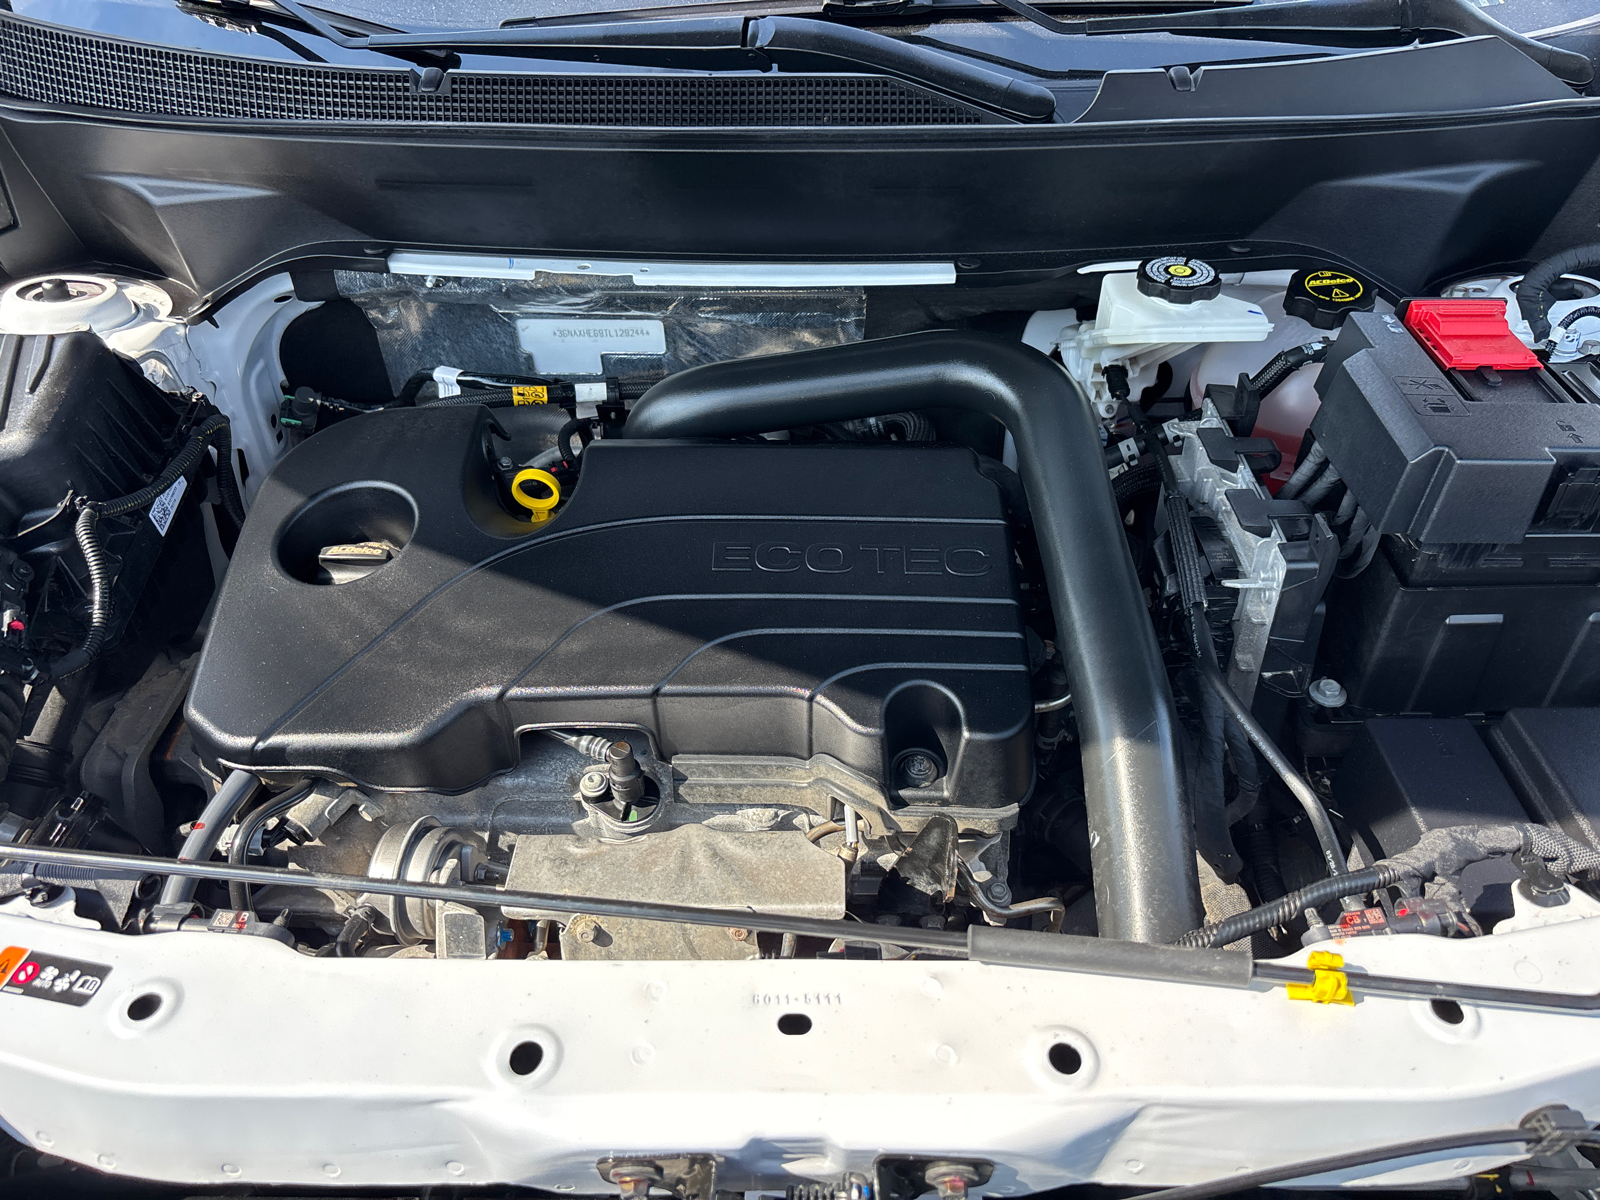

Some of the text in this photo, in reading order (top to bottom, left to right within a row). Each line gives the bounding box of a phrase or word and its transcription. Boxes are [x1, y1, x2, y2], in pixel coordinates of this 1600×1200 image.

[325, 546, 383, 555] ACDelco
[711, 541, 993, 577] ECOTEC
[238, 912, 250, 923] B
[1345, 915, 1361, 925] CB
